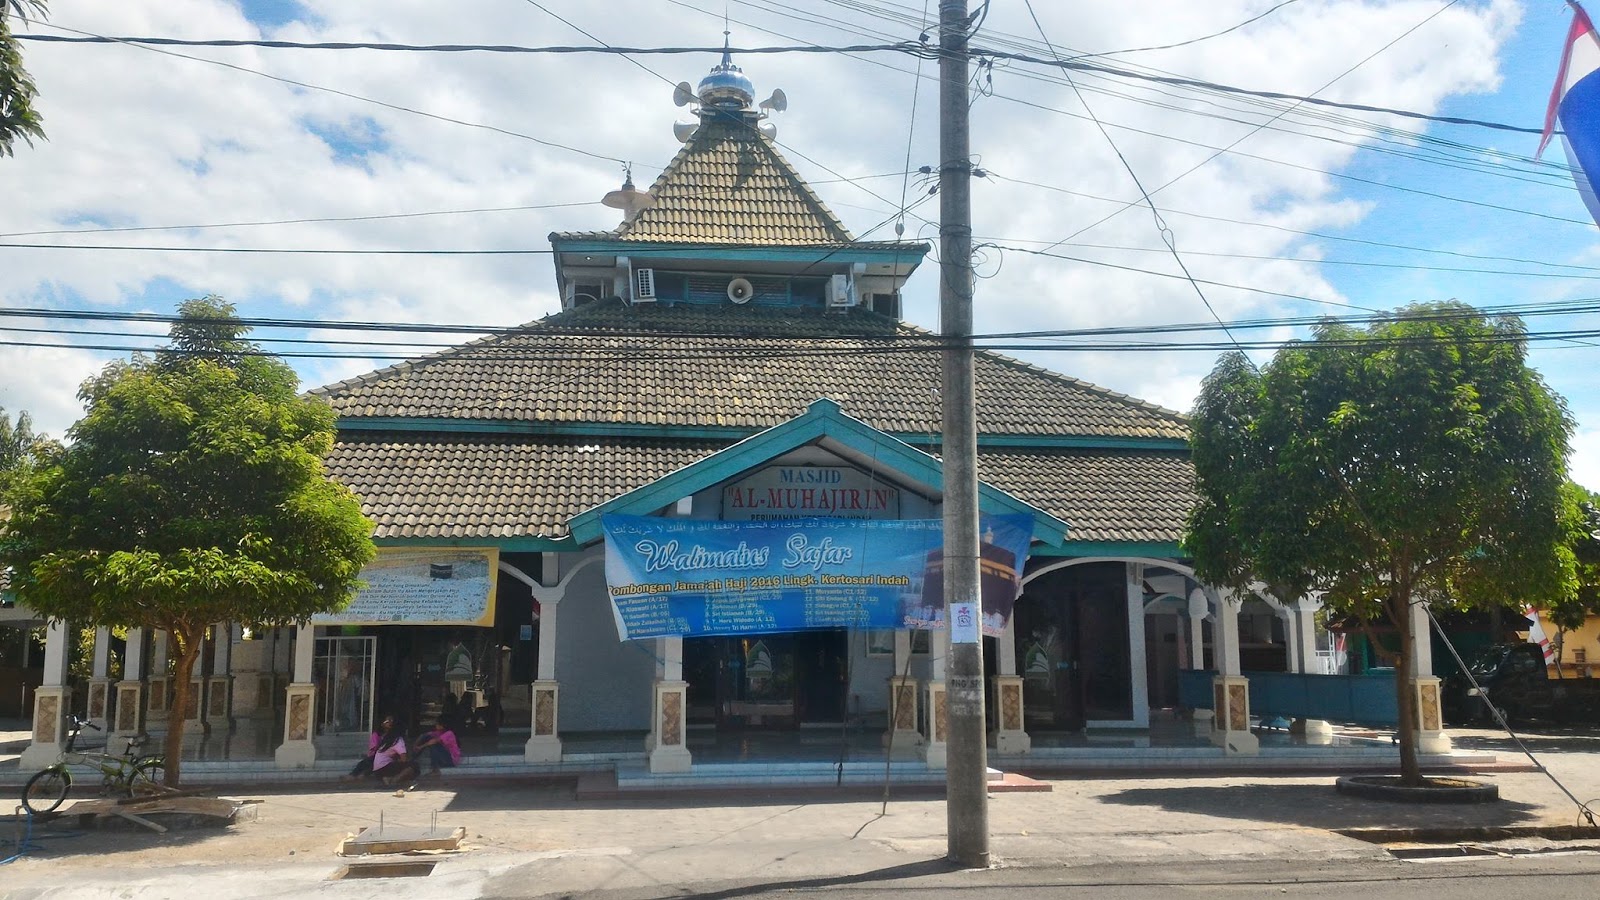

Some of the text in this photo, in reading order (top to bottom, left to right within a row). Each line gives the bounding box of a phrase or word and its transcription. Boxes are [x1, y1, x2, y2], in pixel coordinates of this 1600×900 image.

[780, 469, 841, 484] MASJID
[635, 532, 852, 573] Walimatus Safar
[725, 578, 747, 593] Haji
[750, 576, 780, 587] 2016
[821, 574, 874, 585] Kertosari
[876, 575, 909, 585] Indah
